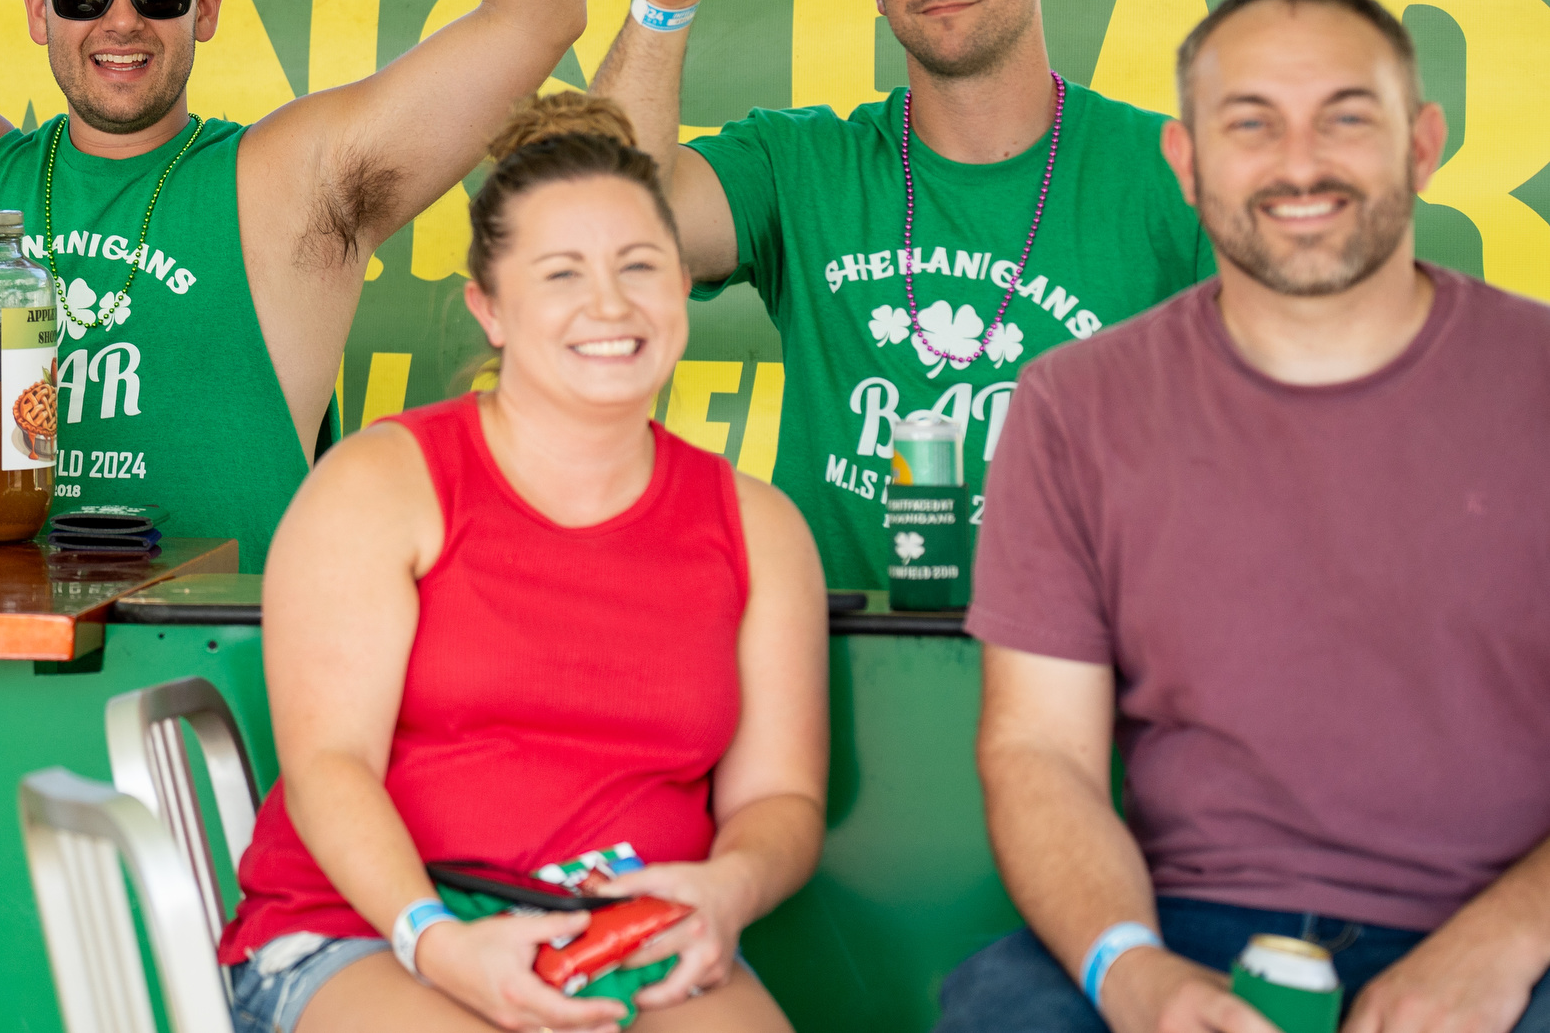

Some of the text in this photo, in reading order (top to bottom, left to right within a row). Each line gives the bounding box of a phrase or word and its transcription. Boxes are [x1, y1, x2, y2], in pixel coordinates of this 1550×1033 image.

[22, 230, 198, 295] NANIGANS
[825, 246, 1103, 341] SHENANIGANS
[56, 342, 142, 424] AR
[54, 483, 82, 498] 018
[89, 451, 147, 479] 2024
